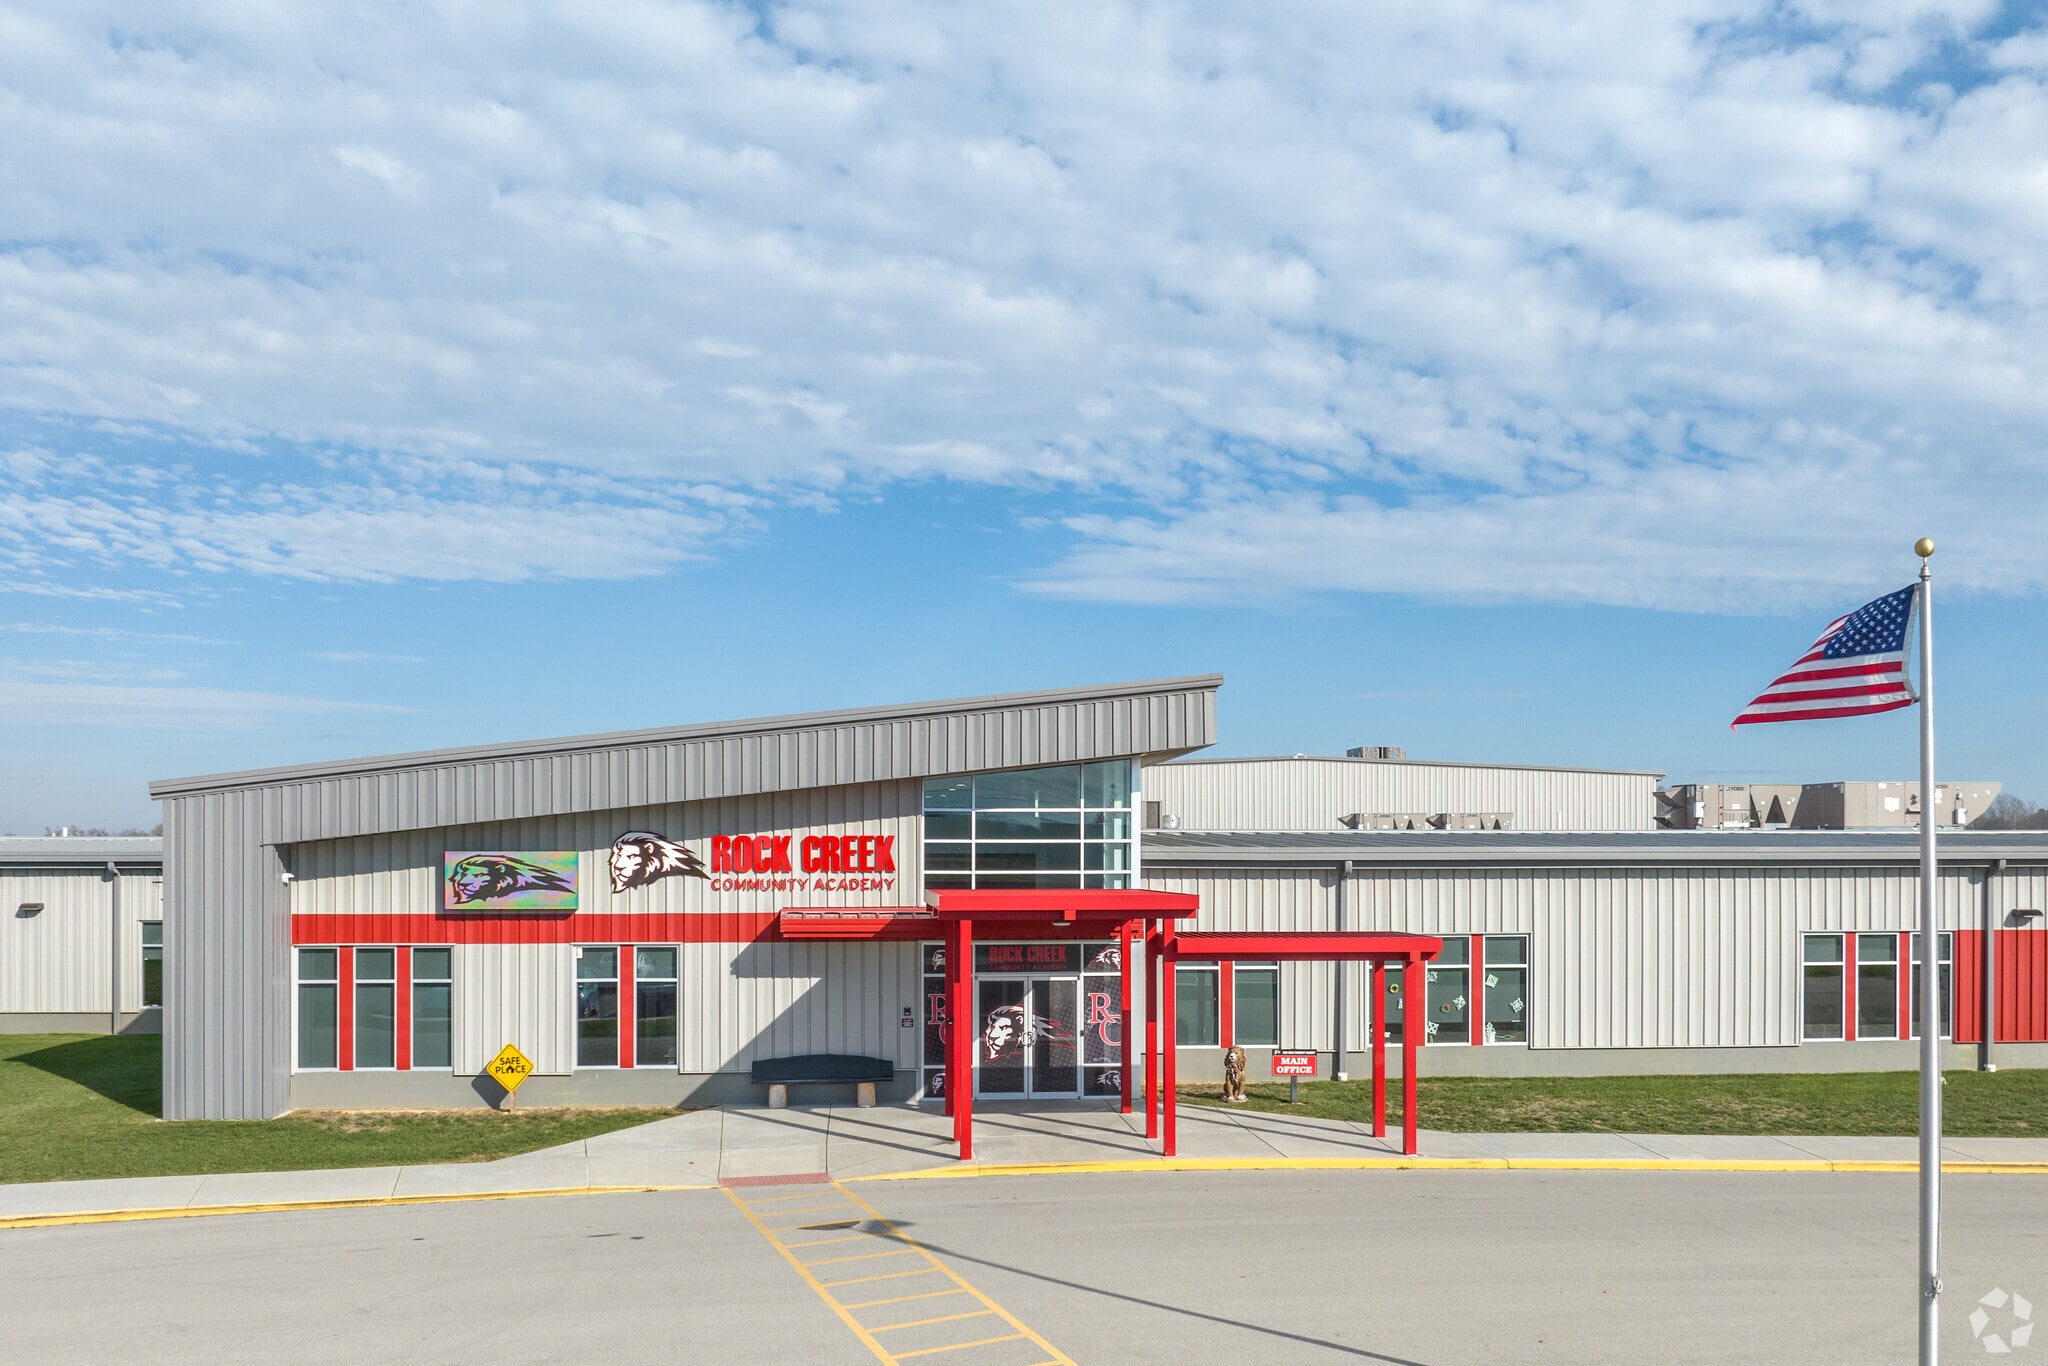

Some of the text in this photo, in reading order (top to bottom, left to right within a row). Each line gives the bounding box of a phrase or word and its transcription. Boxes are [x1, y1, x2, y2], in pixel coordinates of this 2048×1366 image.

[711, 834, 896, 874] ROCK CREEK
[711, 878, 896, 892] COMMUNITY ACADEMY
[989, 946, 1067, 962] ROCK CREEK
[499, 1056, 520, 1065] SAFE
[1280, 1057, 1308, 1065] MAIN
[1276, 1066, 1312, 1074] OFFICE
